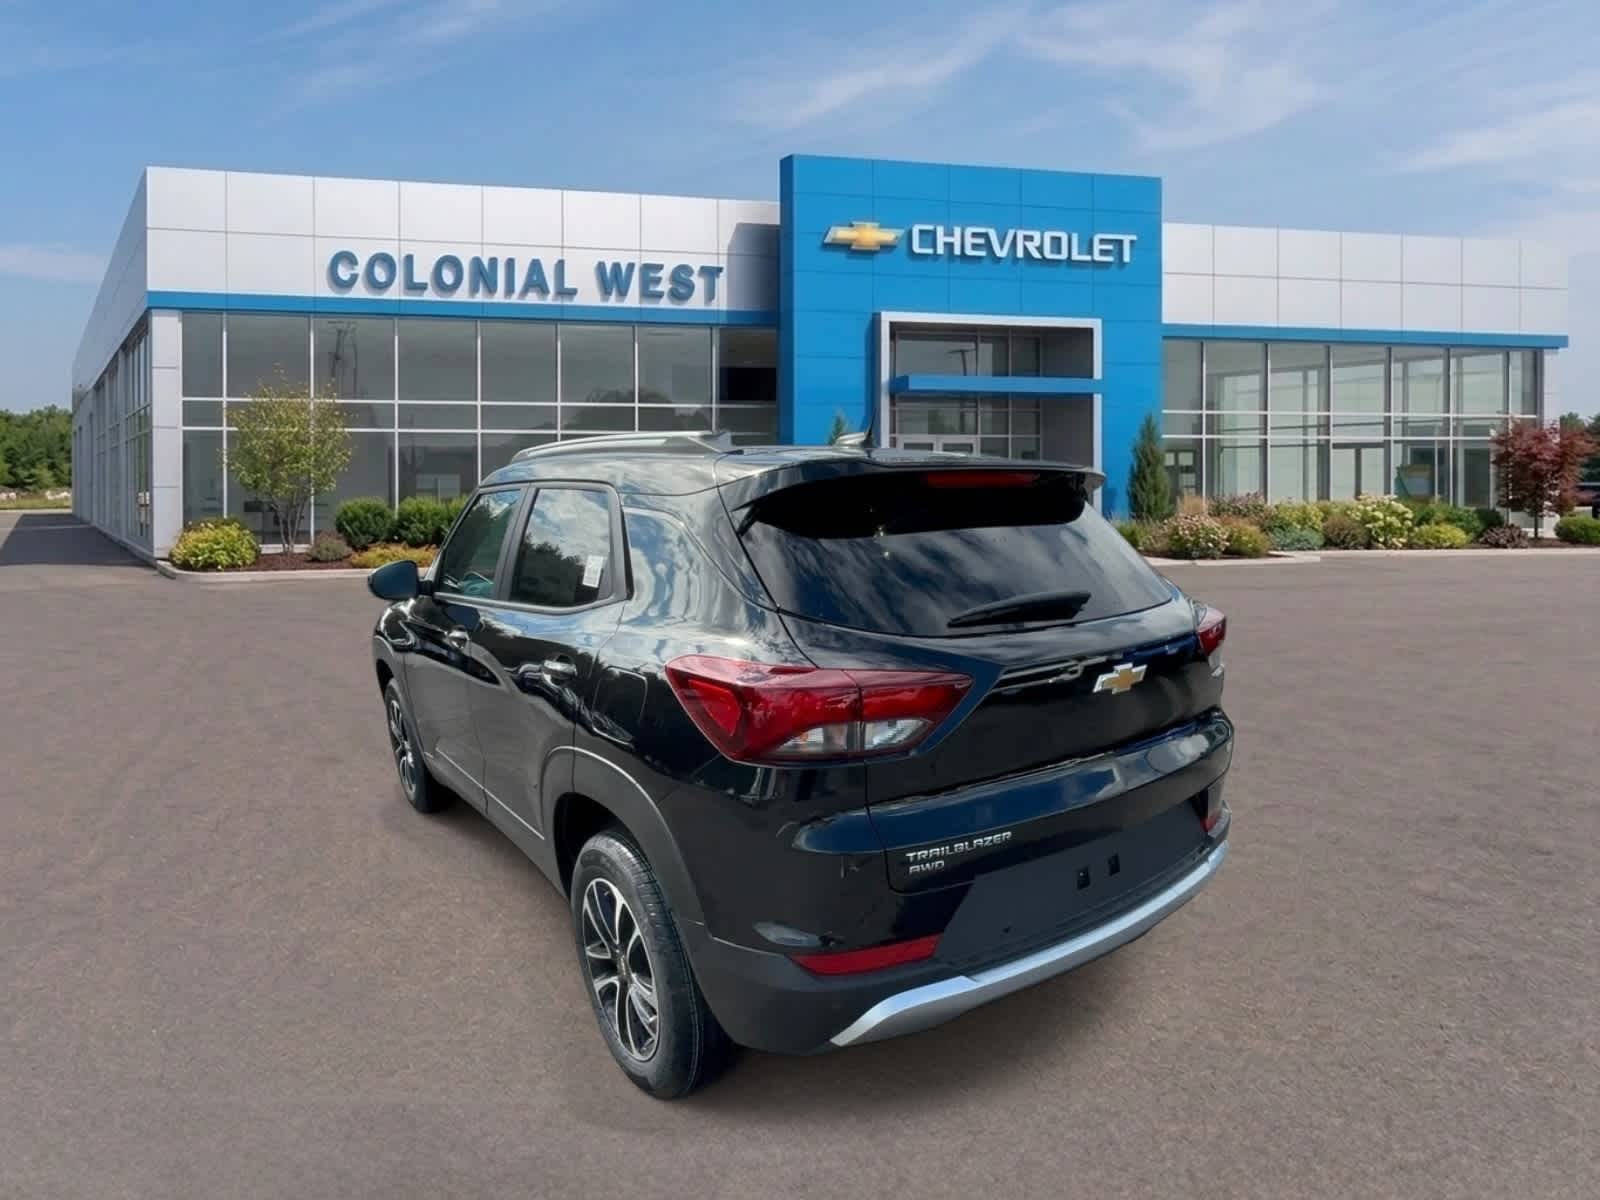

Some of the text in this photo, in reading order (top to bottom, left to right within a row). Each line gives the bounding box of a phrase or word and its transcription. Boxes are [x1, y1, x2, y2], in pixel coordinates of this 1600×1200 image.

[911, 223, 1138, 264] CHEVROLET
[328, 250, 724, 304] COLONIAL WEST
[906, 831, 1012, 863] TRAILBLAZER
[908, 860, 945, 875] AWD
